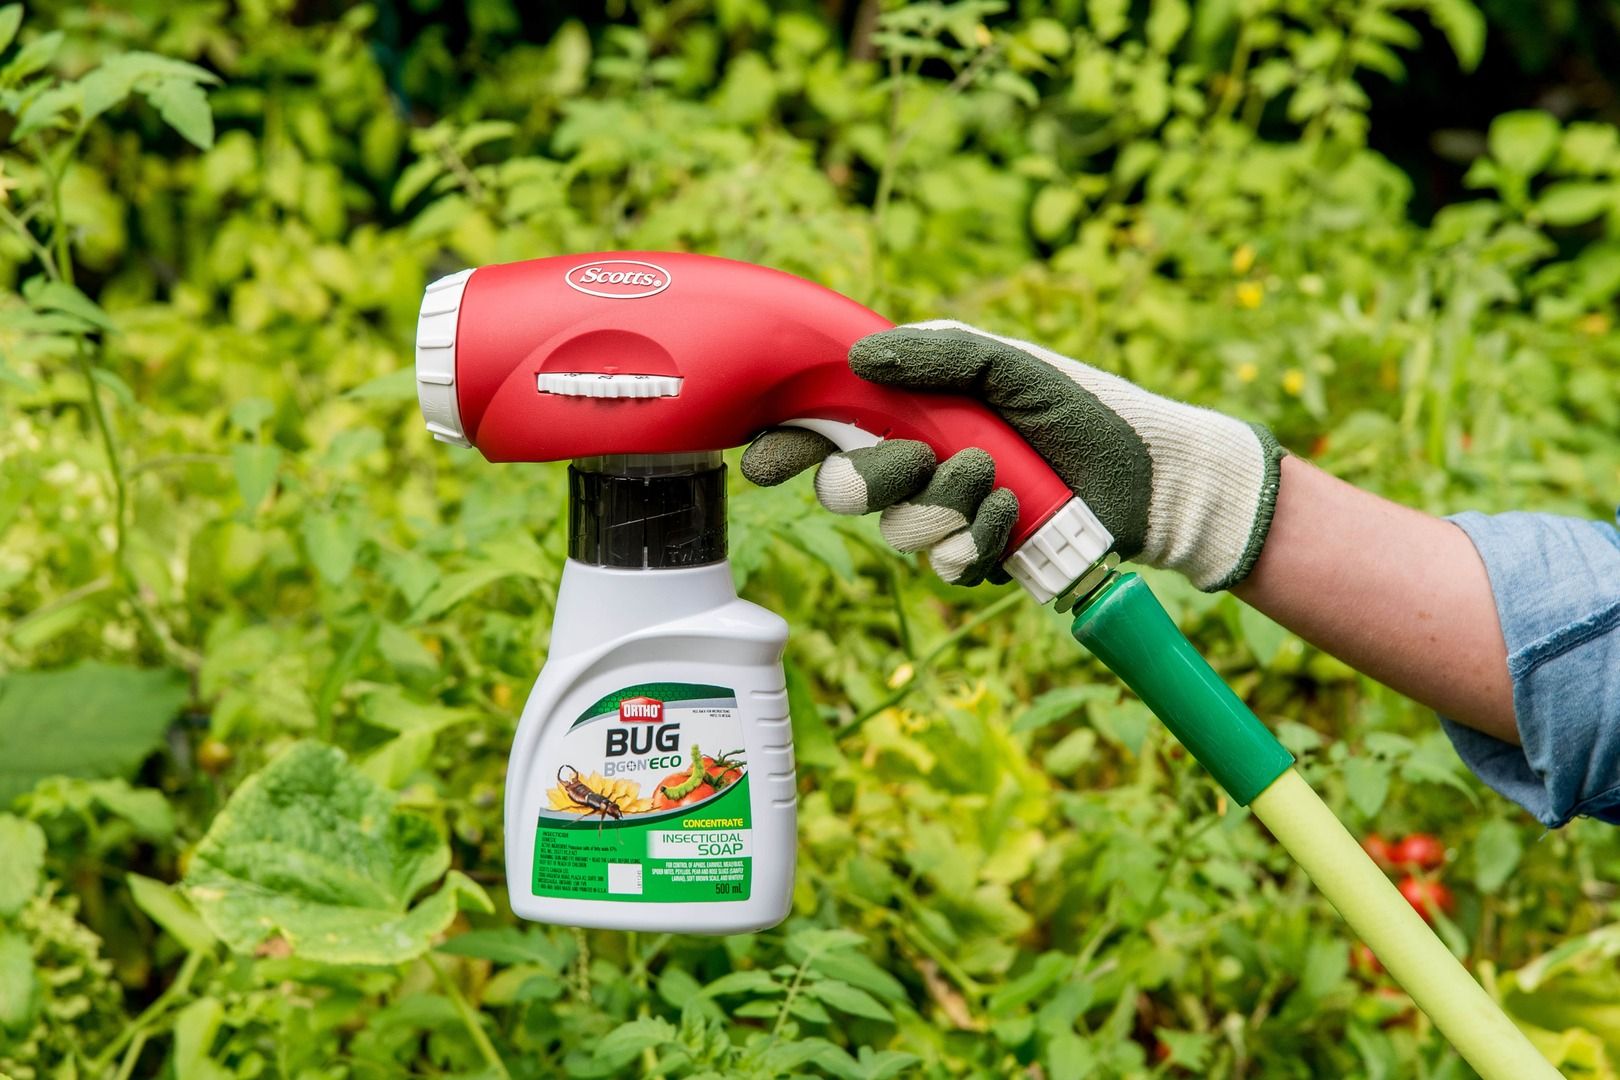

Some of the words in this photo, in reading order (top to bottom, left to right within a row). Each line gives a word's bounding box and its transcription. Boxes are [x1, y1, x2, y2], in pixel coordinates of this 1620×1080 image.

[623, 704, 658, 718] ORTHO
[606, 723, 680, 757] BUG
[649, 755, 682, 770] ECO
[683, 818, 744, 828] CONCENTRATE
[663, 833, 744, 843] INSECTICIDAL
[698, 843, 744, 856] SOAP
[716, 883, 729, 894] 500
